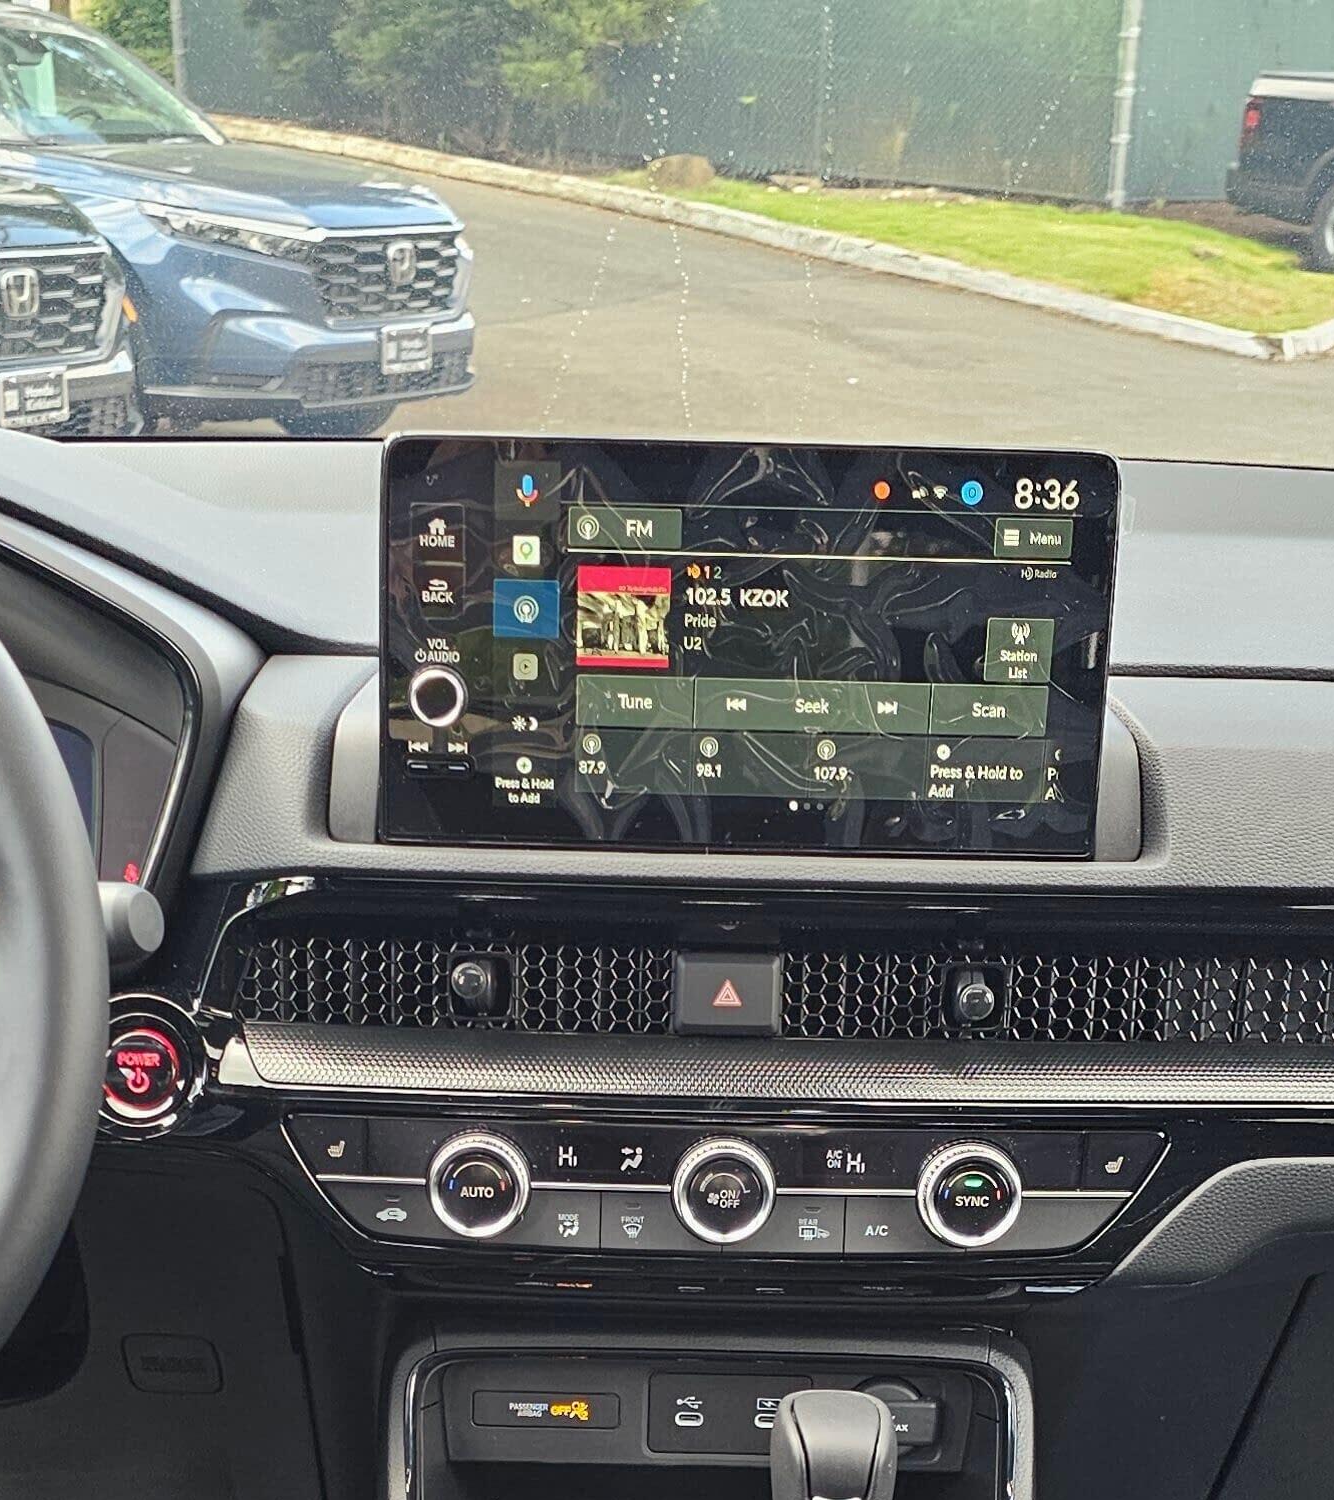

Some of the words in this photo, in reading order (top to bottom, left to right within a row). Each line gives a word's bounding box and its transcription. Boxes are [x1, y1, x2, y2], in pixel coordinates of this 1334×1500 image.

[1014, 478, 1080, 511] 8:36
[625, 518, 653, 539] FM
[419, 534, 455, 548] HOME
[1029, 531, 1062, 547] Menu
[1034, 568, 1058, 579] Radio
[422, 590, 455, 604] BACK
[685, 587, 731, 606] 102.5
[739, 588, 790, 608] KZOK
[684, 613, 717, 629] Pride
[426, 637, 450, 651] VOL
[683, 635, 703, 651] U2
[427, 650, 460, 663] AUDIO
[999, 649, 1038, 663] Station
[1008, 666, 1028, 680] List
[618, 694, 653, 710] Tune
[794, 698, 830, 715] Seek
[972, 702, 1007, 718] Scan
[578, 760, 606, 774] 87.9
[695, 763, 722, 778] 98.1
[813, 766, 848, 780] 107.9
[930, 764, 962, 779] Press
[964, 766, 976, 780] &
[977, 765, 1007, 780] Hold
[1010, 767, 1023, 780] to
[494, 776, 520, 789] Press
[531, 778, 555, 790] Hold
[508, 792, 519, 804] to
[520, 792, 541, 804] Add
[928, 784, 955, 798] Add
[116, 1051, 162, 1067] POWER
[825, 1149, 844, 1160] A/C
[826, 1159, 842, 1170] ON
[460, 1186, 495, 1199] AUTO
[719, 1199, 740, 1209] OFF
[954, 1196, 990, 1208] SYNC
[557, 1213, 580, 1222] MODE
[620, 1215, 645, 1224] FRONT
[864, 1224, 889, 1237] A/C
